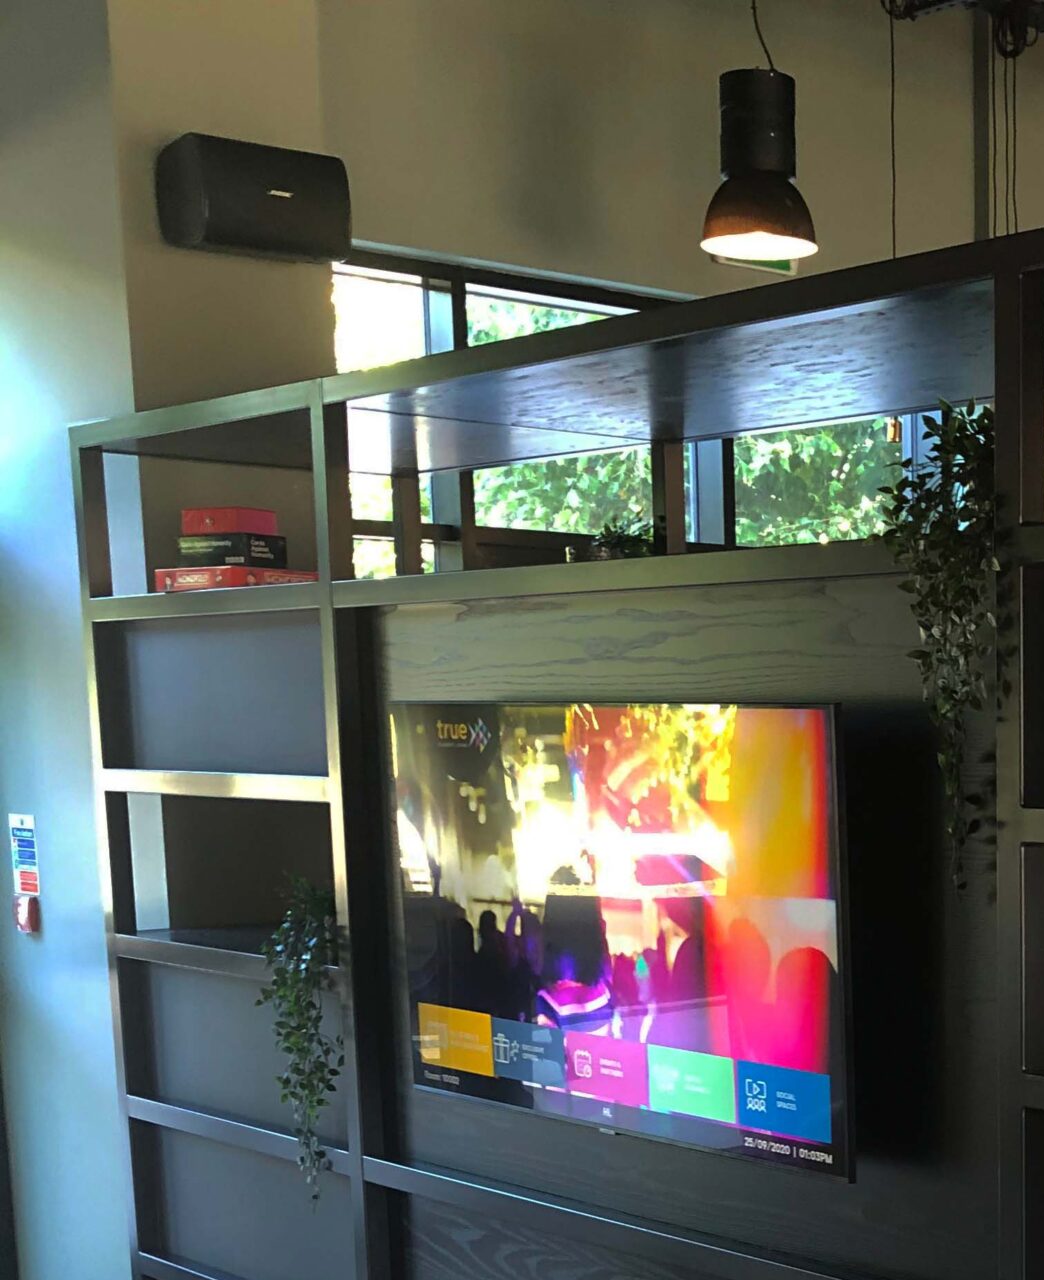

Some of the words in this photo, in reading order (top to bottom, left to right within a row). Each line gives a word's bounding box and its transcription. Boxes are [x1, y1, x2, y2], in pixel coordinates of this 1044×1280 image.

[436, 719, 468, 740] true
[744, 1136, 791, 1155] 25/09/2020
[799, 1148, 833, 1164] 01:03PM
